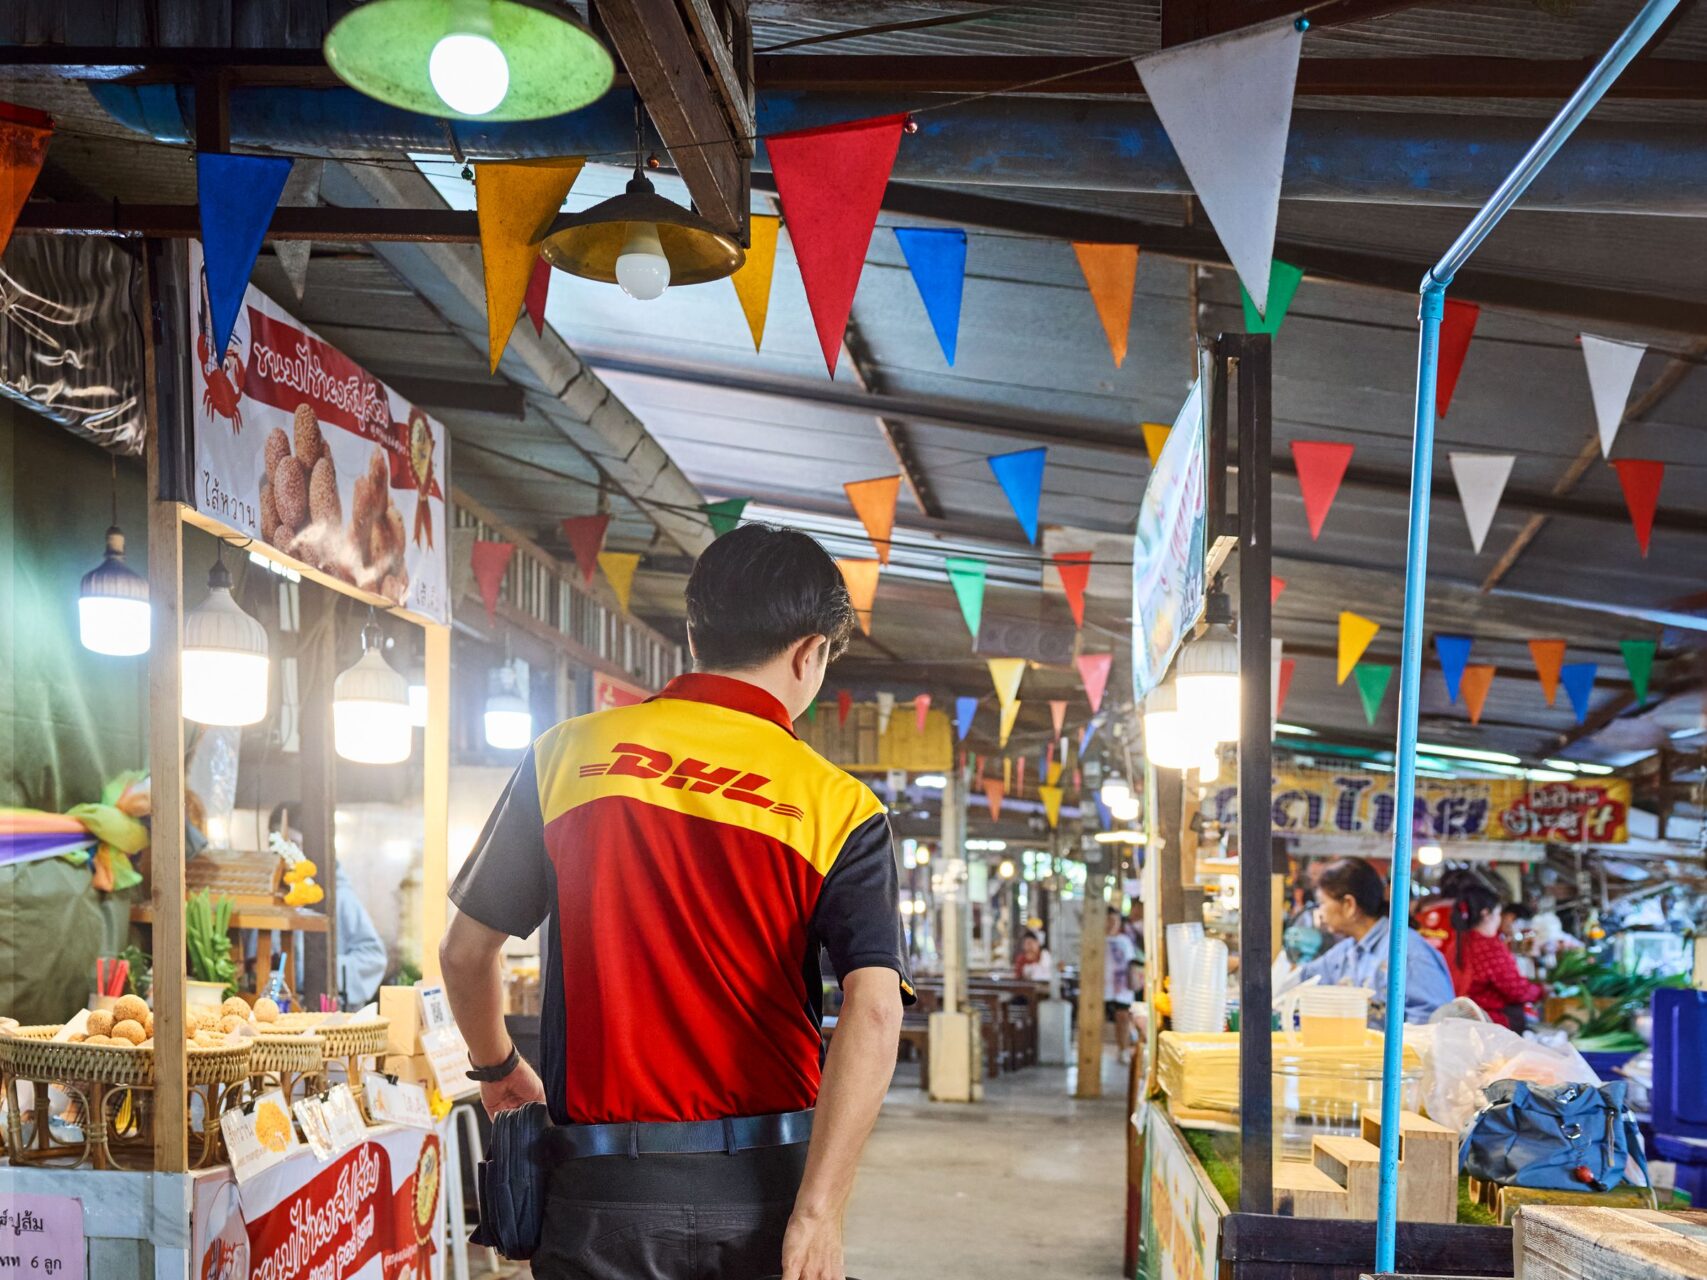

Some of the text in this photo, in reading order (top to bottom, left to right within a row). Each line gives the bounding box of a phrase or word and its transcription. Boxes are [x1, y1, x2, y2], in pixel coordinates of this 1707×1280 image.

[203, 469, 256, 528] ไส้หวาน
[606, 743, 772, 809] DHL
[31, 1256, 39, 1268] 6
[44, 1258, 62, 1275] ลูก
